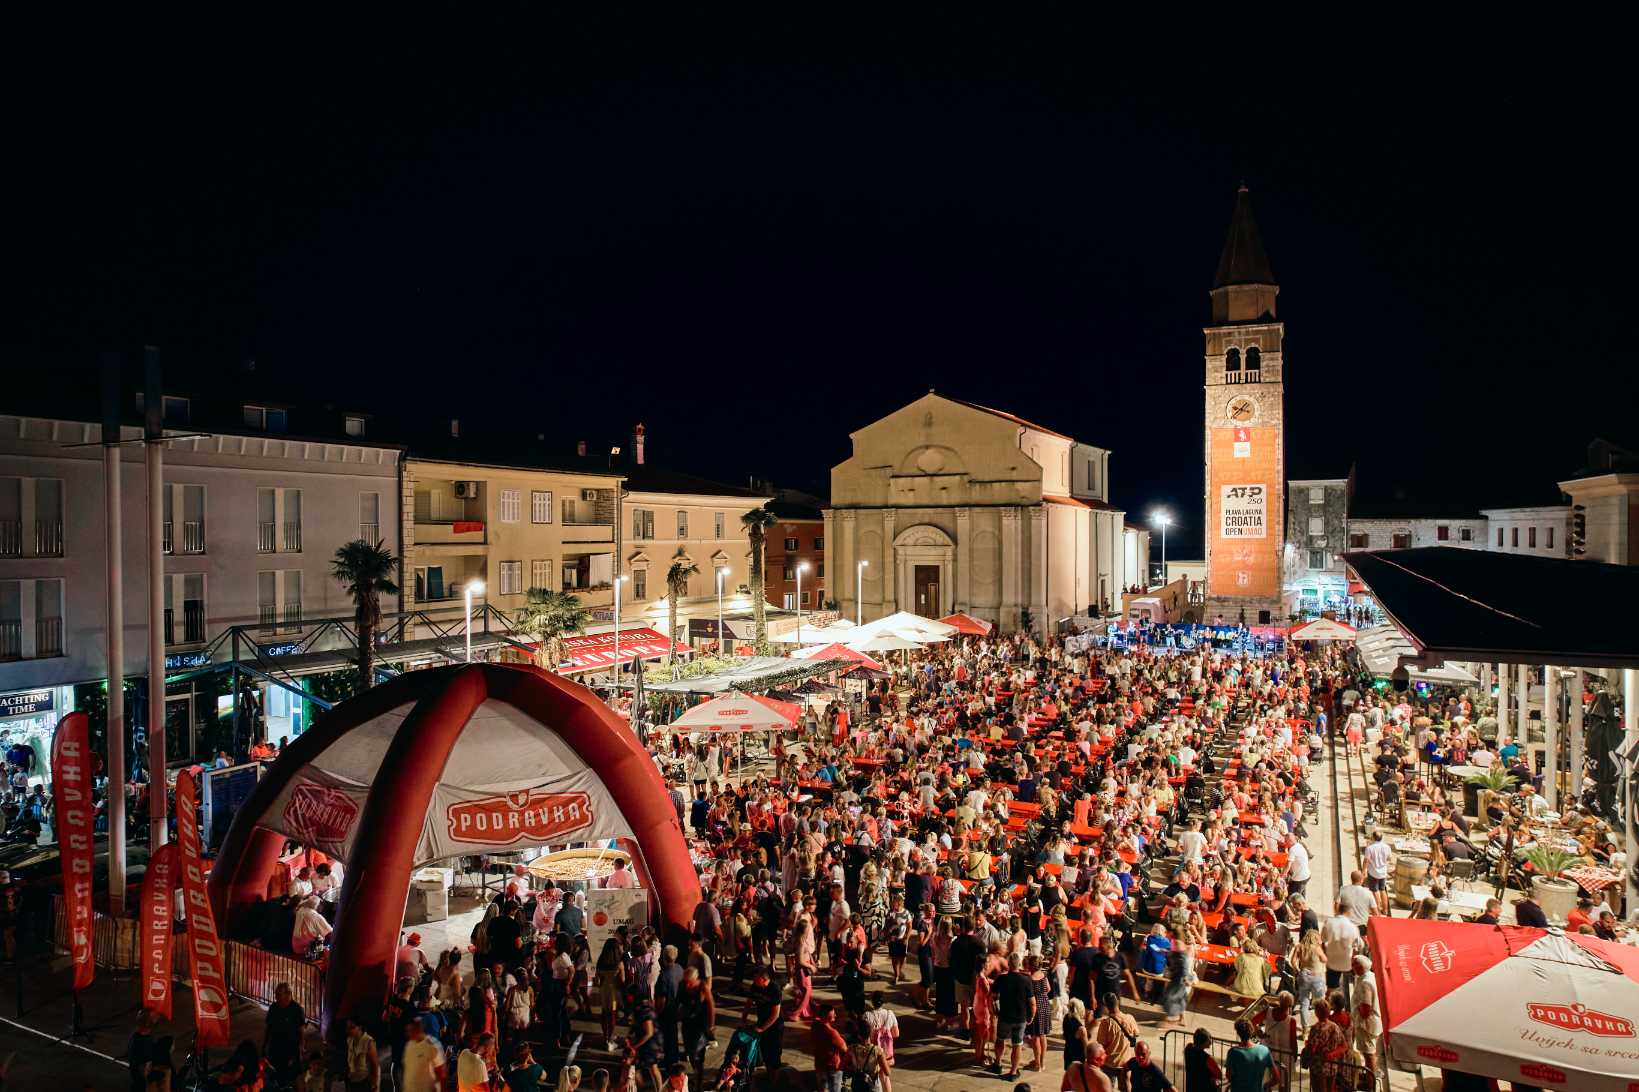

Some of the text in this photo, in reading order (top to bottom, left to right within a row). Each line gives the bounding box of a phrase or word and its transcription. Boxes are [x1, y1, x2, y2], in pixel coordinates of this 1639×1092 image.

[1226, 516, 1262, 526] CROATIA
[0, 693, 49, 706] ACHTING
[8, 704, 36, 715] TIME
[460, 802, 580, 832] PODRAVKA
[181, 793, 220, 979] PODRAVKA
[1536, 1008, 1627, 1032] PODRAVKA
[1581, 1044, 1600, 1056] sa
